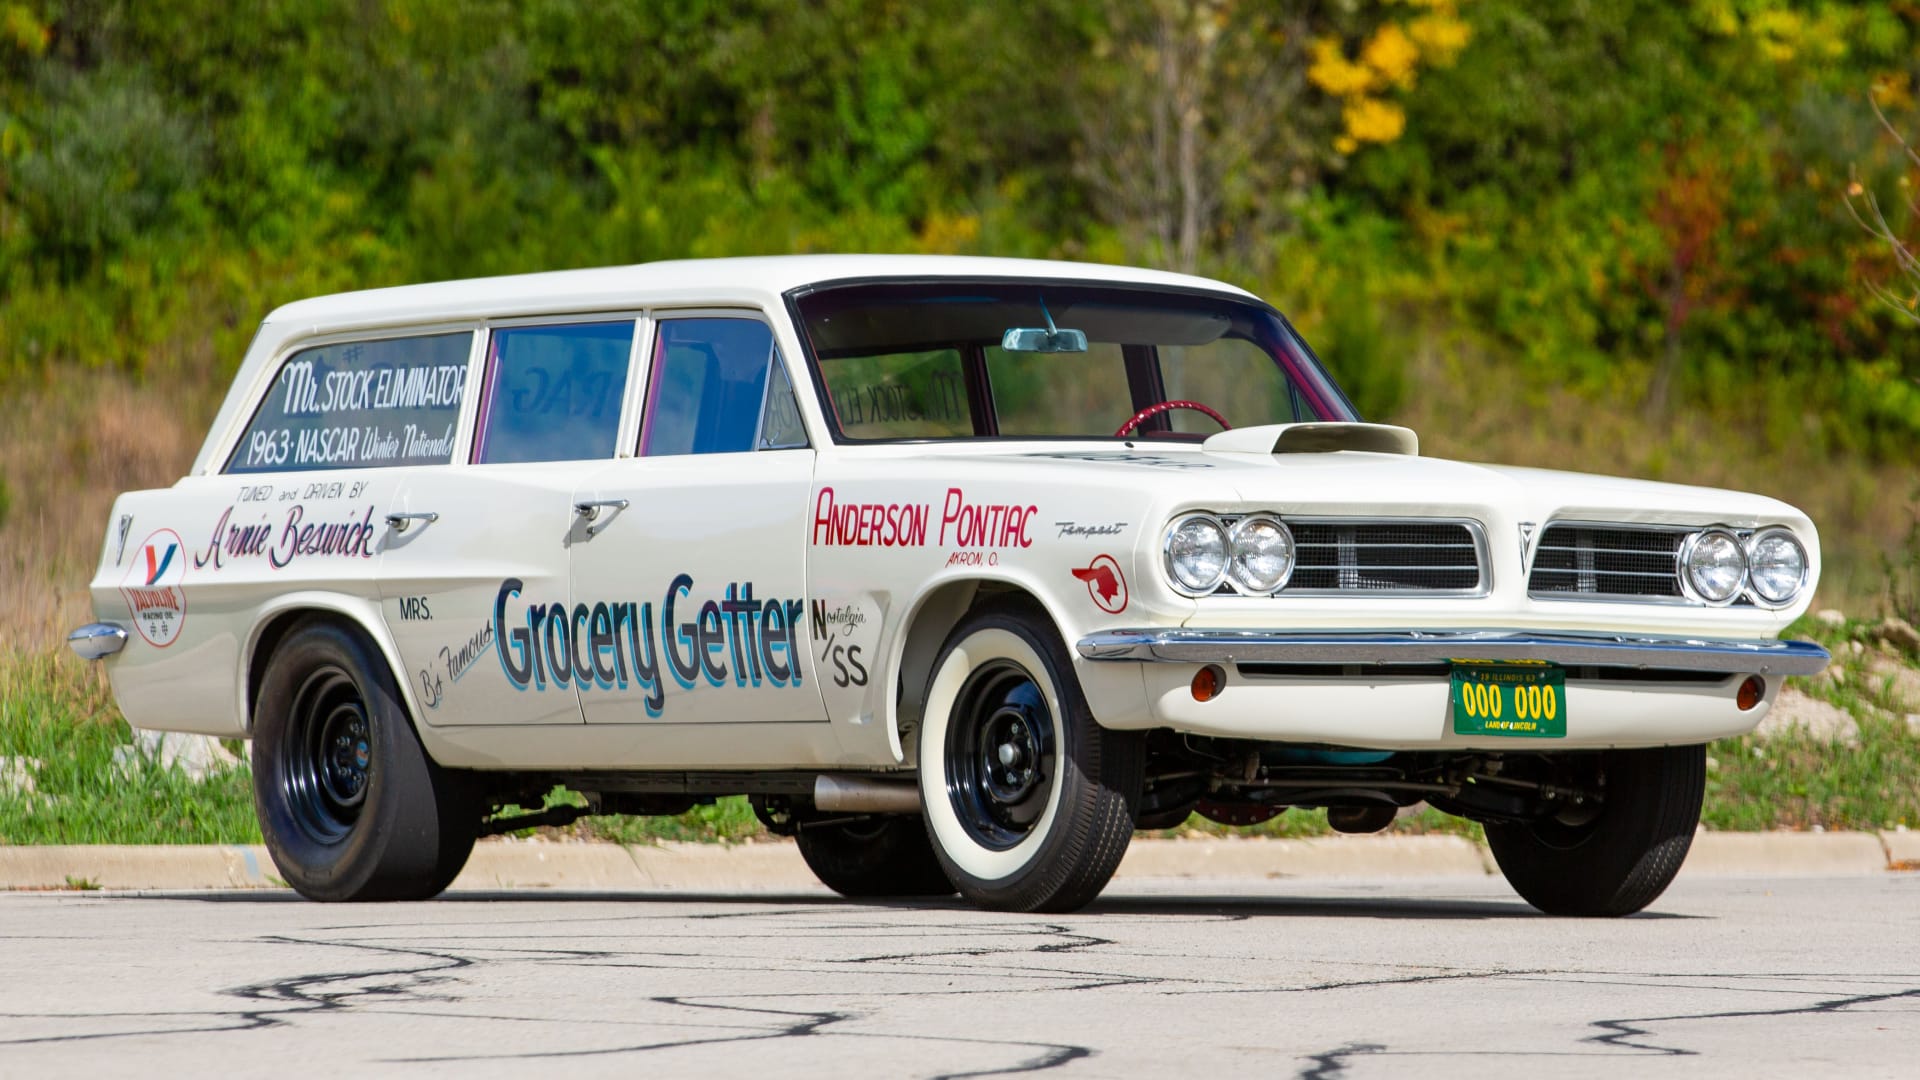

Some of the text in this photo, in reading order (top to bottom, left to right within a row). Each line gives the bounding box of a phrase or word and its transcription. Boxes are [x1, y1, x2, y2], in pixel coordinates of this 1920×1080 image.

[282, 361, 467, 414] Mr. STOCK ELIMINATOR
[295, 427, 360, 464] NASCAR
[361, 425, 399, 460] Winter
[402, 423, 455, 458] Nationals
[237, 481, 369, 502] TUNED and DRIVEN BY
[812, 487, 1038, 548] ANDERSON PONTIAC
[1055, 521, 1129, 540] Tempest
[194, 504, 375, 571] Arnie Beswick
[988, 551, 999, 567] O.
[126, 585, 180, 612] VALVOLINE
[400, 597, 433, 620] MRS.
[143, 611, 174, 620] RACING OIL
[439, 618, 494, 681] Famous
[493, 573, 804, 718] Grocery Getter
[1492, 673, 1523, 682] ILLINOIS
[1462, 682, 1557, 720] 000 000
[1485, 721, 1500, 730] LAND
[1509, 721, 1537, 731] LINCOLN
